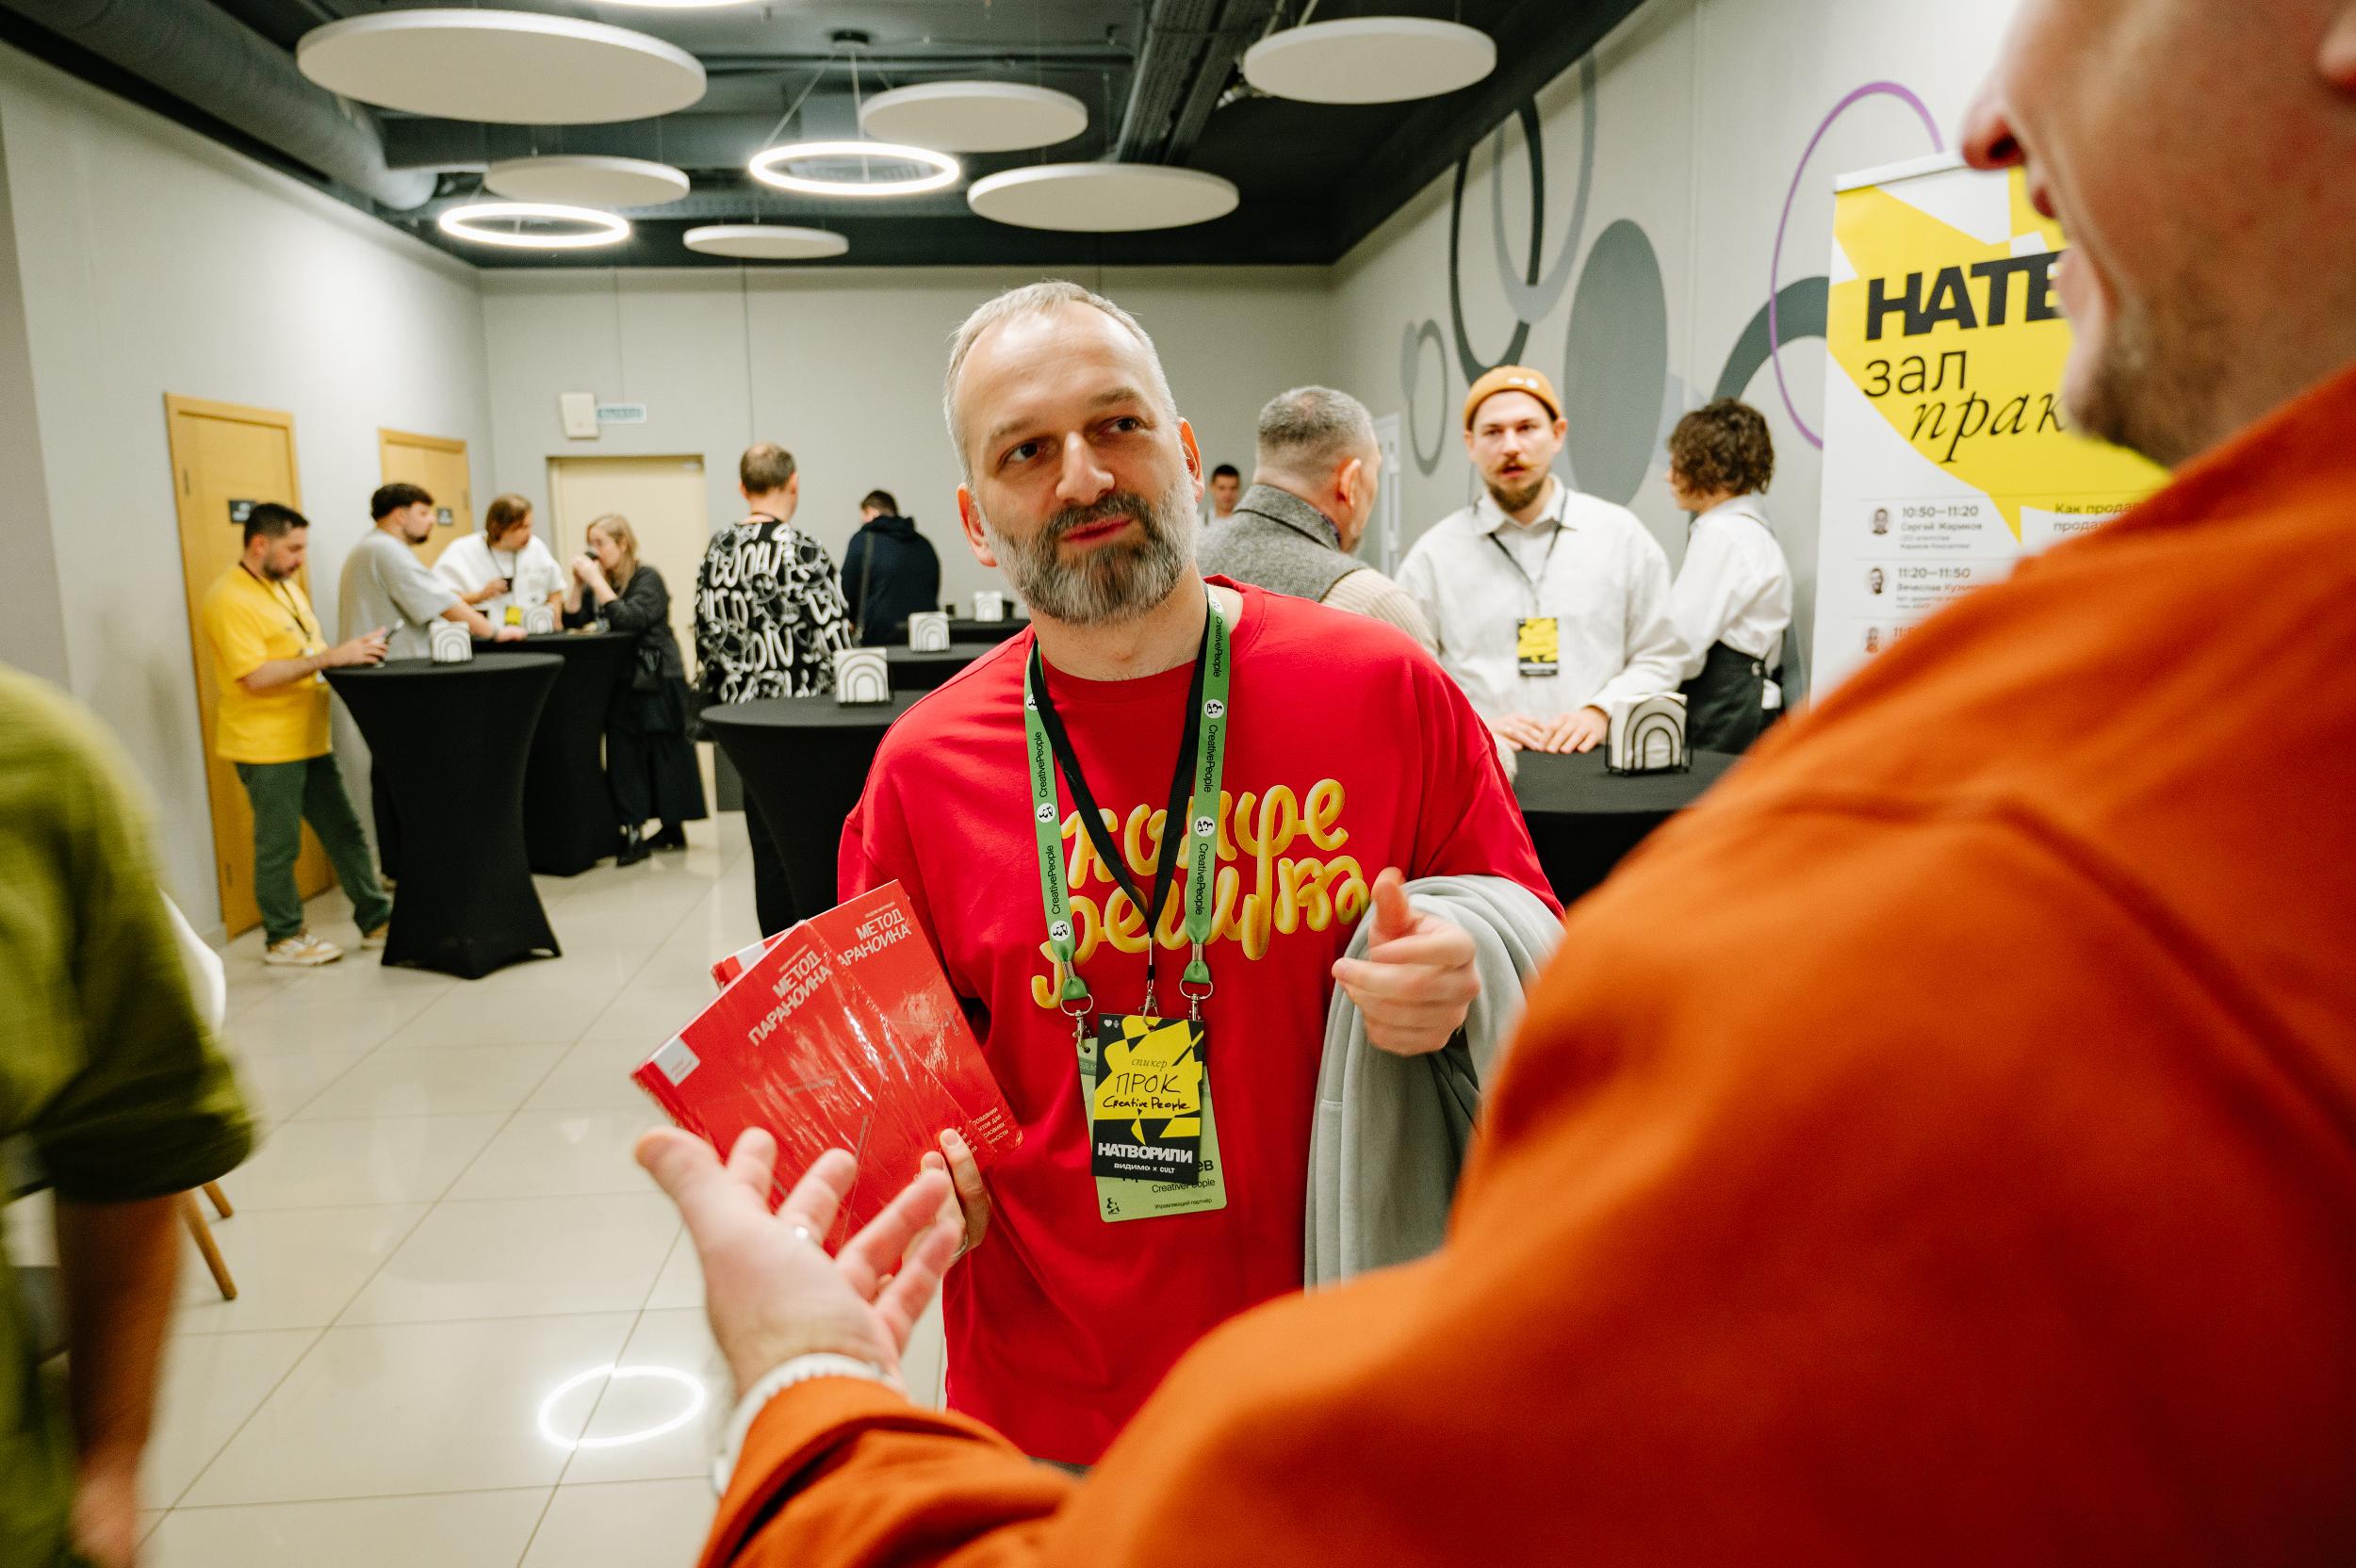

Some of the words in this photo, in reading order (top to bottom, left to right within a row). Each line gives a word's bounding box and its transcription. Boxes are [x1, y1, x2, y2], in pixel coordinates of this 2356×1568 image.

[1863, 350, 1967, 398] зал
[2054, 502, 2082, 514] Как
[2086, 502, 2135, 515] прода
[2053, 521, 2103, 532] прода
[1212, 615, 1223, 678] CreativePeople
[1034, 731, 1049, 799] CreativePeople
[1203, 724, 1219, 793] CreativePeople
[1046, 844, 1062, 915] CreativePeople
[1194, 842, 1209, 916] CreativePeople
[855, 907, 906, 941] МЕТОД
[772, 949, 823, 999] МЕТОД
[1131, 1058, 1168, 1071] спикер
[1116, 1072, 1182, 1096] ПРОК
[1103, 1095, 1149, 1109] Creative
[1151, 1096, 1190, 1111] People
[1097, 1142, 1193, 1165] НАТВОРИЛИ
[1159, 1166, 1176, 1174] CULT
